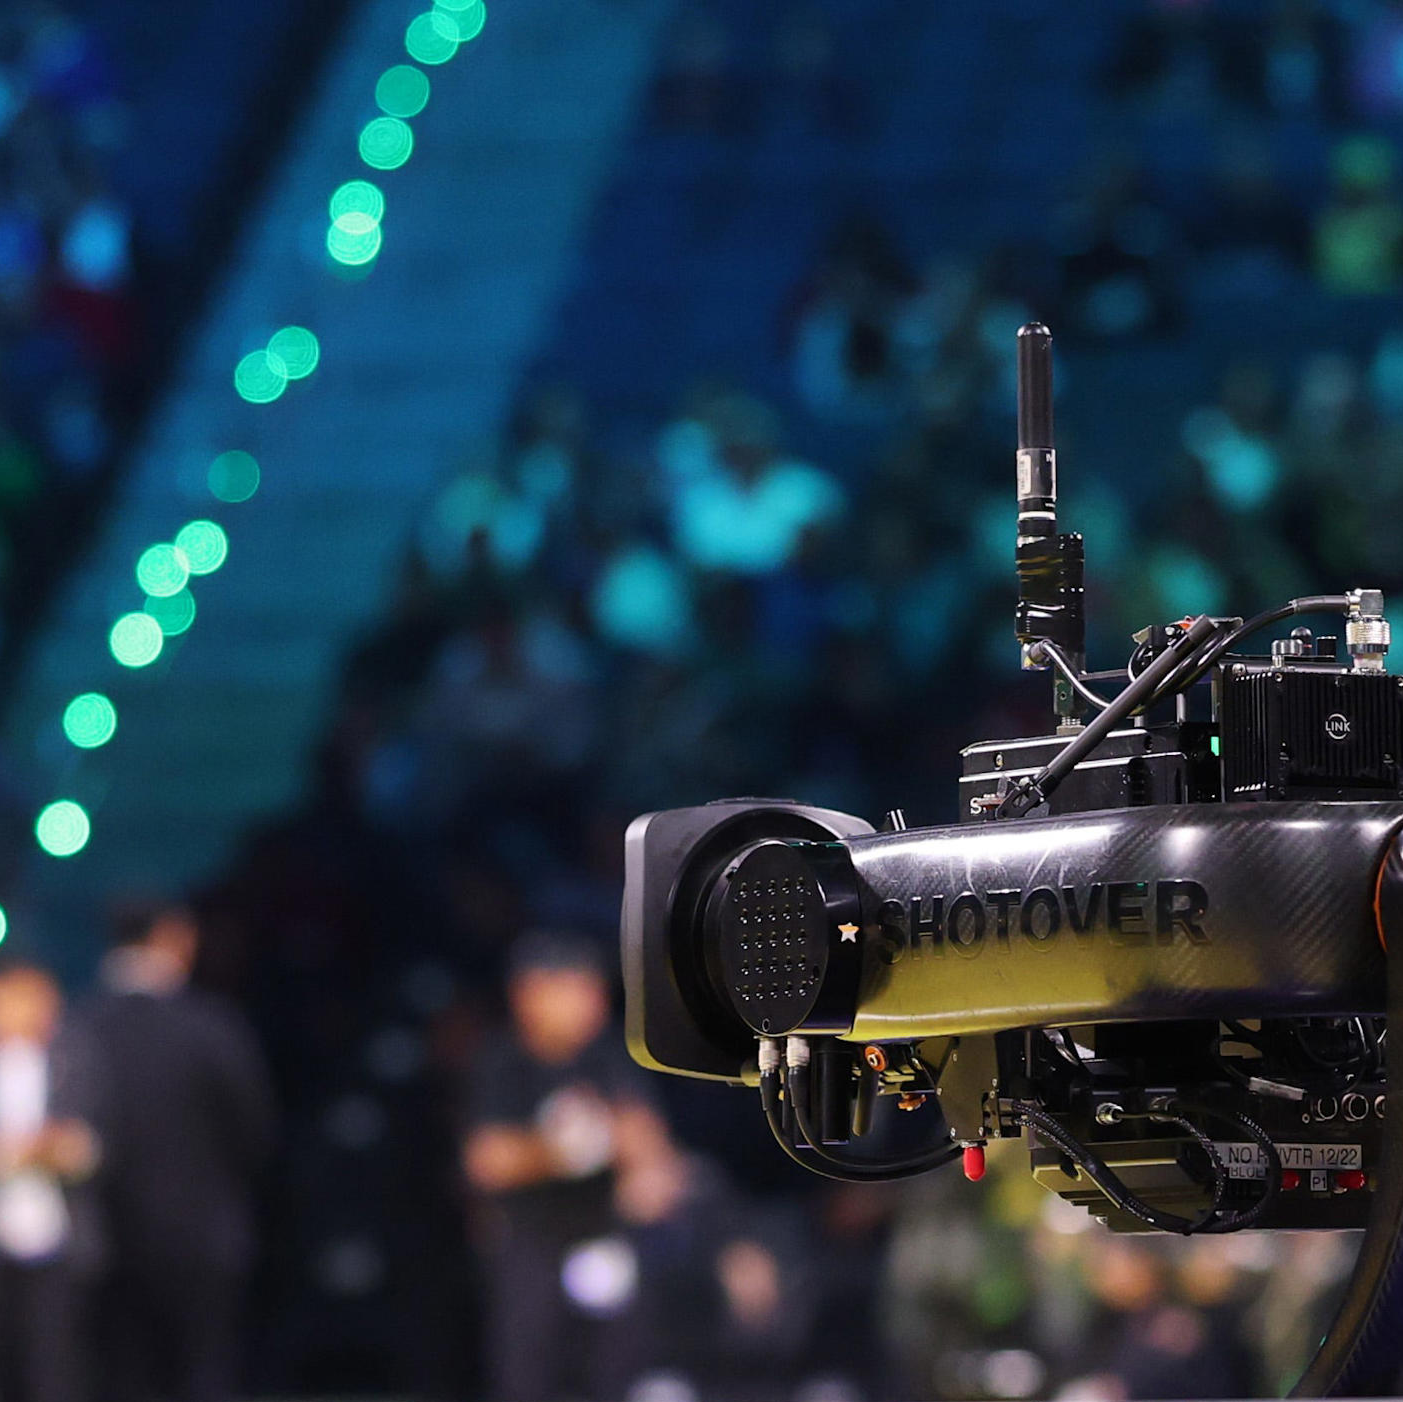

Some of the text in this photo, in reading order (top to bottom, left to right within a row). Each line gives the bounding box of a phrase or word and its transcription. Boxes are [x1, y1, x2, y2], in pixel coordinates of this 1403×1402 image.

[1325, 721, 1351, 732] LINK
[878, 880, 1211, 965] SHOTOVER
[1229, 1147, 1252, 1164] NO
[1320, 1148, 1358, 1166] 12/22
[1313, 1176, 1326, 1189] P1
